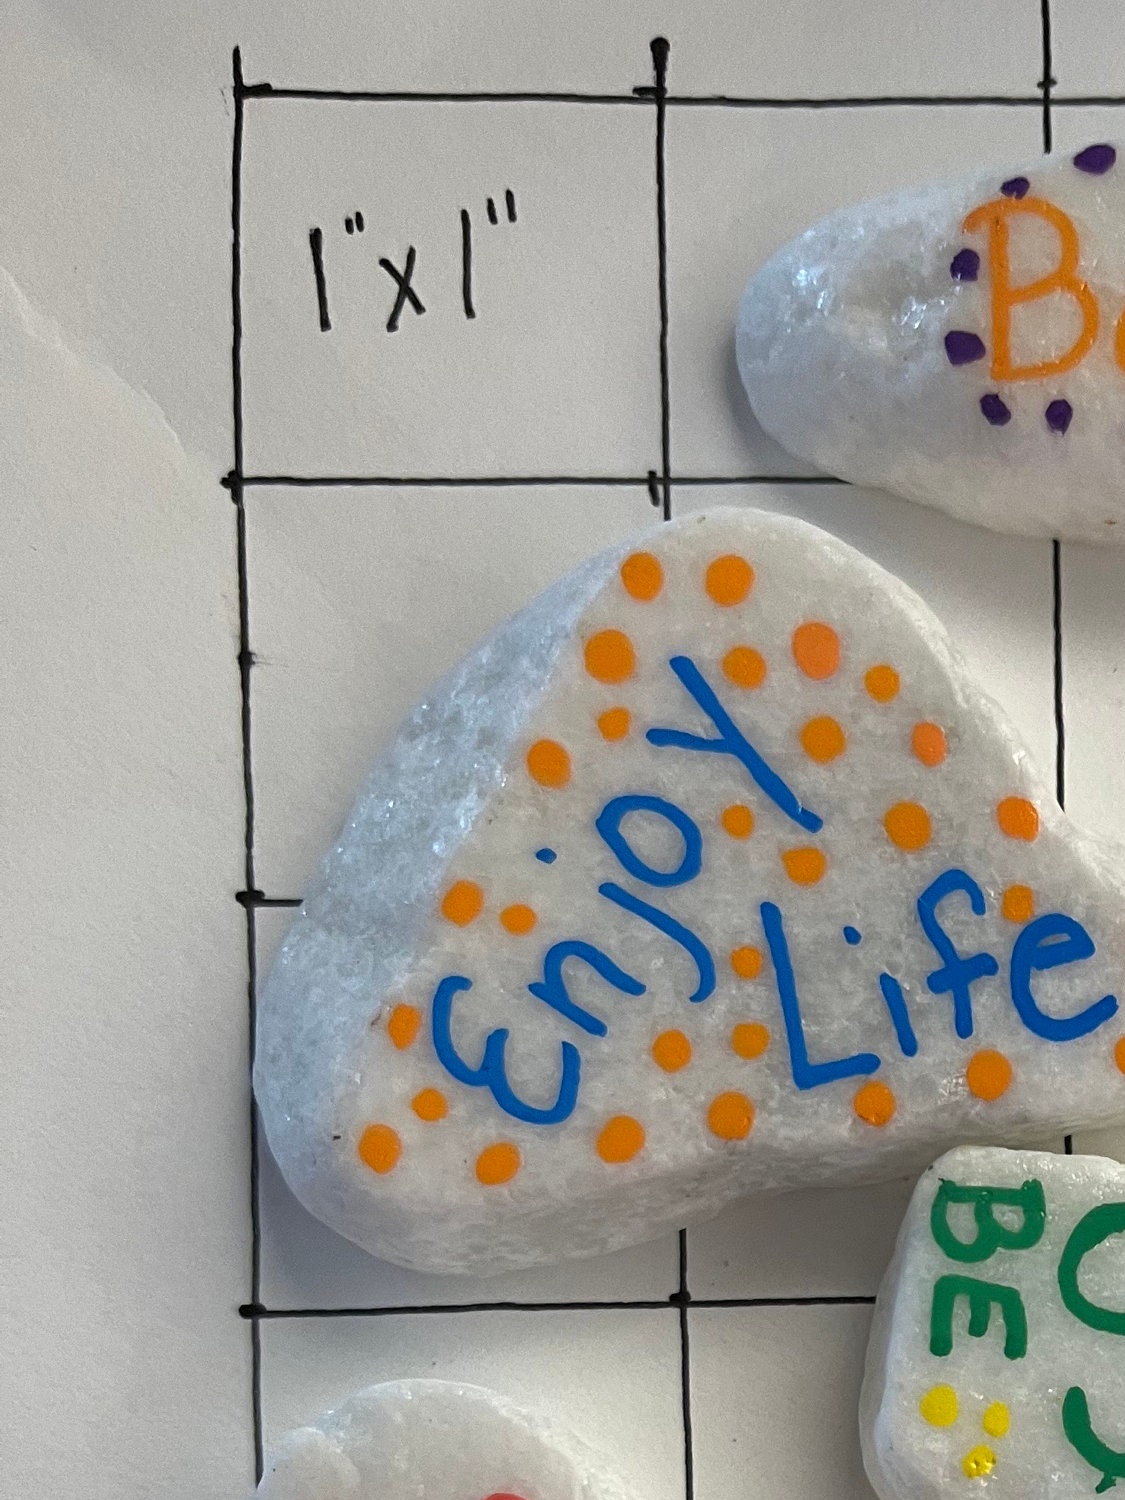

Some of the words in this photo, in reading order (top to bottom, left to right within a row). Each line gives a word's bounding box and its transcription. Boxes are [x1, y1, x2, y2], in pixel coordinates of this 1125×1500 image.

[432, 655, 823, 1125] Enjoy
[761, 869, 1119, 1090] Life
[928, 1177, 1047, 1359] BE
